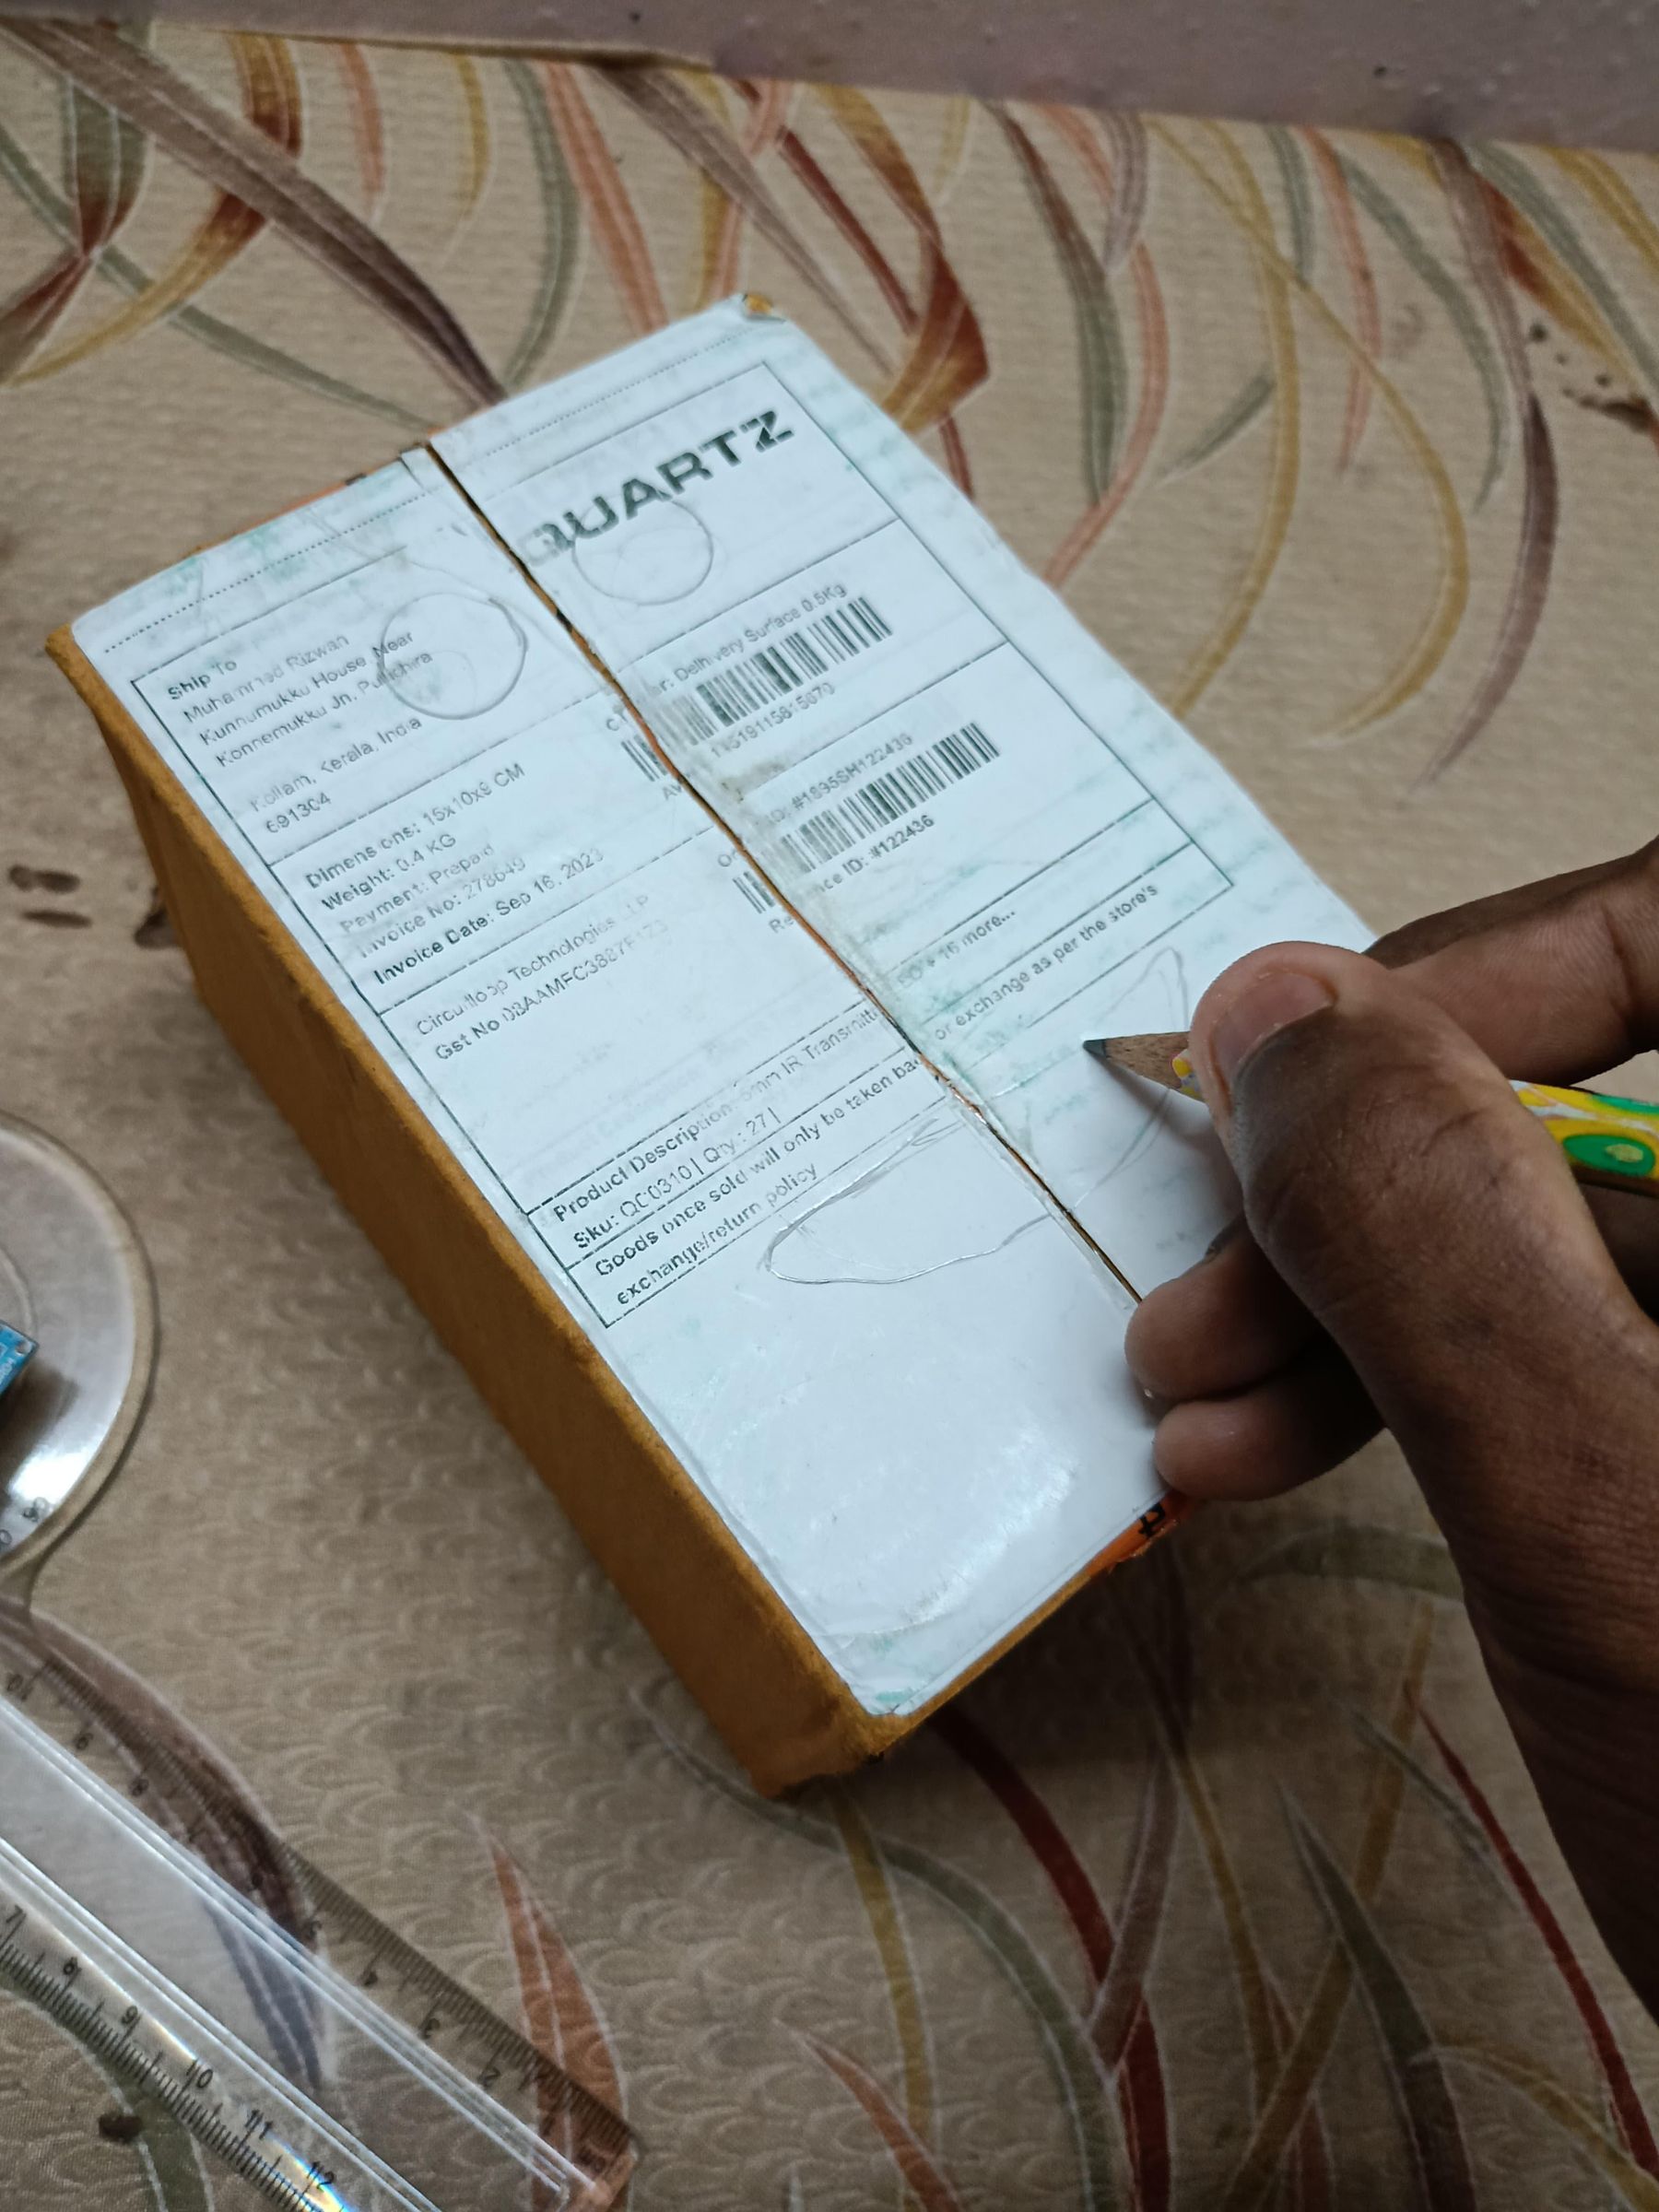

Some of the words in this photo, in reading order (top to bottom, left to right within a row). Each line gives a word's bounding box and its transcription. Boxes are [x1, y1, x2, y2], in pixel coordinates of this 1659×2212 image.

[166, 669, 214, 703] Ship
[213, 654, 239, 676] To
[286, 631, 350, 672] Rizwan
[371, 629, 415, 659] Near
[674, 637, 747, 685] Delhivery
[744, 605, 801, 643] Surface
[801, 581, 849, 615] 0.5Kg
[216, 702, 329, 769] Konnemukku
[377, 713, 422, 745] India
[265, 792, 332, 836] 691304
[305, 818, 421, 889] Dimensons:
[492, 763, 525, 789] CM
[841, 852, 870, 877] ID:
[868, 811, 936, 861] #122436
[321, 864, 397, 914] Weight:
[394, 848, 426, 872] 0.4
[426, 831, 458, 856] KG
[338, 877, 431, 937] Payment:
[429, 841, 497, 887] Prepaid
[372, 935, 445, 985] Invoice
[444, 909, 496, 947] Date:
[494, 887, 534, 918] Sep
[560, 845, 606, 879] 2023
[933, 1021, 954, 1042] or
[952, 968, 1034, 1032] exchange
[1030, 954, 1053, 976] as
[1052, 935, 1083, 965] per
[1077, 915, 1109, 944] the
[1106, 882, 1159, 925] store's
[959, 903, 1018, 948] more...
[415, 976, 512, 1038] Circutloop
[507, 915, 619, 985] Technologies
[433, 1030, 474, 1062] Gst
[471, 1014, 503, 1041] No
[552, 1162, 629, 1223] Product
[780, 1052, 805, 1077] IR
[571, 1209, 621, 1251] Sku:
[745, 1112, 771, 1137] 27
[594, 1225, 661, 1278] Goods
[658, 1194, 708, 1236] once
[705, 1166, 749, 1204] sold
[747, 1145, 782, 1176] will
[780, 1118, 824, 1158] only
[819, 1101, 847, 1128] be
[844, 1071, 894, 1112] taken
[615, 1195, 765, 1311] exchange/return
[763, 1161, 822, 1209] policy
[4, 1905, 23, 1925] 7
[120, 2005, 139, 2026] 9
[183, 2058, 216, 2089] 10
[302, 2159, 337, 2194] 12
